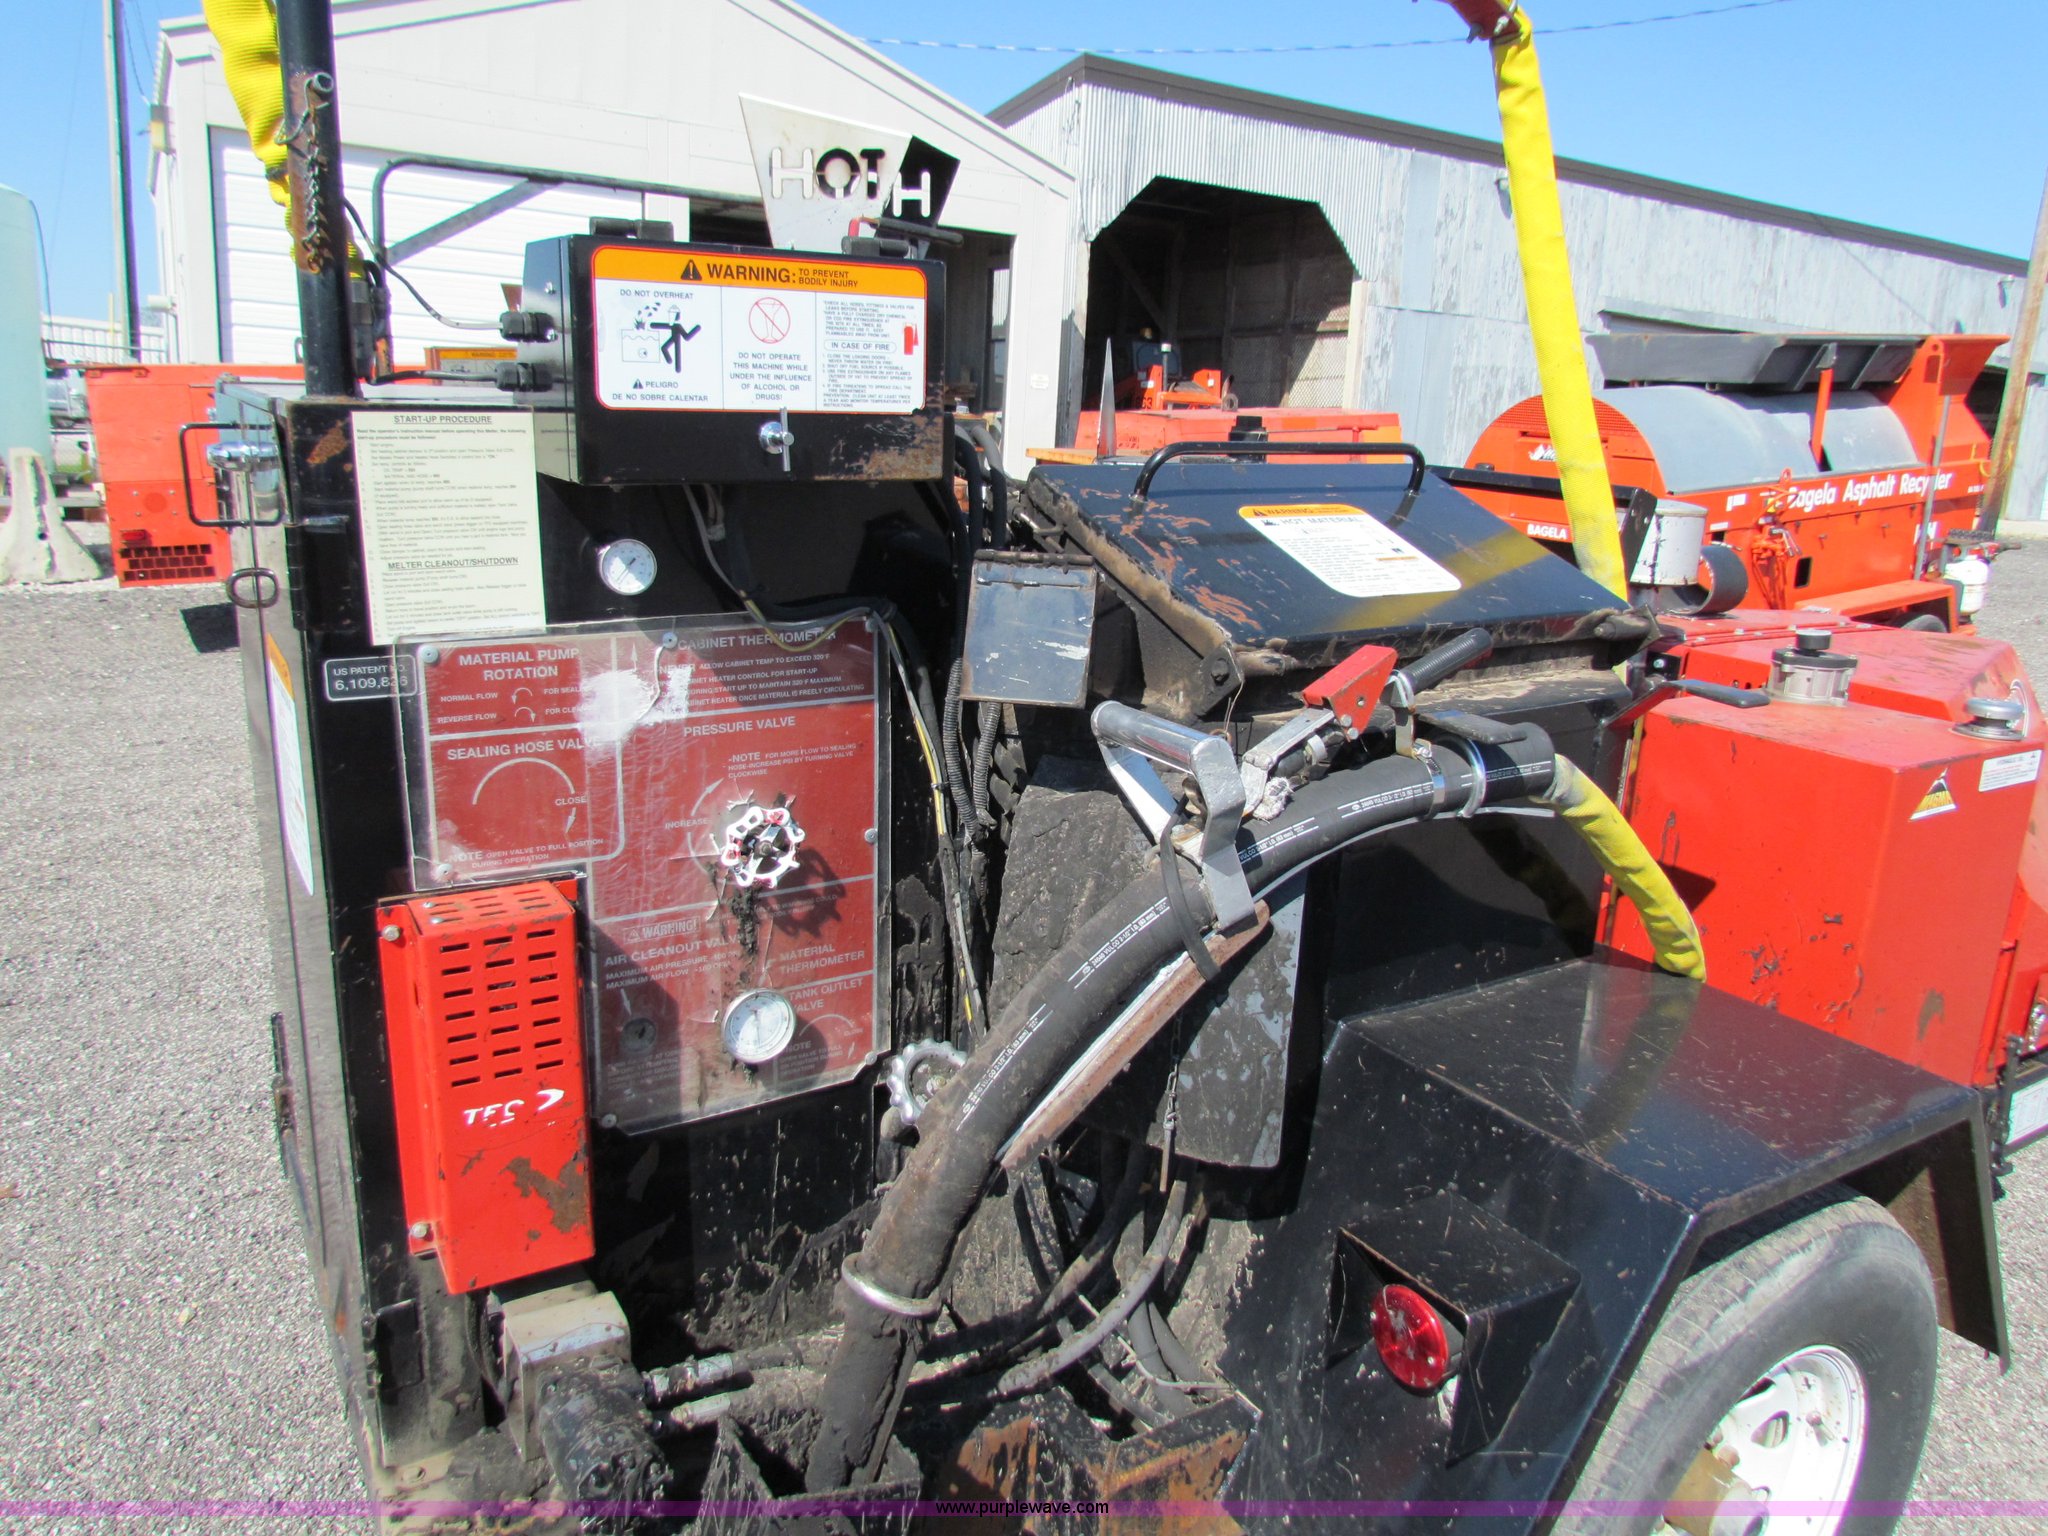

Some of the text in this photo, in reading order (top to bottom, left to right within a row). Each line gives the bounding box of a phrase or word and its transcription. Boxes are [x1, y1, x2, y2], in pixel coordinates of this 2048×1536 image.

[770, 148, 885, 200] HOT
[707, 263, 796, 284] WARNING:
[799, 268, 849, 278] TO PREVENT
[799, 277, 858, 288] BODILY INJURY
[620, 289, 631, 297] DO
[653, 291, 693, 300] OVERHEAT
[738, 352, 749, 360] DO
[769, 353, 800, 361] OPERATE
[733, 362, 749, 370] THIS
[645, 381, 679, 389] PELIGRO
[754, 383, 787, 391] ALCOHOL
[394, 415, 492, 423] START-UP PROCEDURE
[1842, 474, 1896, 506] Asphalt
[1899, 468, 1953, 498] Recyler
[1527, 523, 1568, 540] BAGELA
[388, 557, 518, 569] MELTER CLEANOUT/SHUTDOWN
[677, 635, 736, 650] CABINET
[459, 648, 580, 666] MATERIAL PUMP
[699, 662, 724, 670] ALLOW
[725, 659, 755, 668] CABINET
[756, 657, 774, 665] TEMP
[786, 654, 811, 663] EXCEED
[333, 668, 348, 676] US
[350, 666, 388, 675] PATENT
[483, 666, 559, 681] ROTATION
[708, 675, 736, 683] HEATER
[737, 671, 772, 681] CONTROL
[786, 667, 817, 676] START-UP
[738, 684, 748, 692] UP
[758, 680, 791, 689] MAINTAIN
[810, 676, 842, 684] MAXIMUM
[440, 692, 498, 703] NORMAL FLOW
[738, 693, 758, 702] ONCE
[758, 690, 790, 700] MATERIAL
[799, 688, 822, 696] FREELY
[824, 684, 864, 693] CIRCULATING
[437, 713, 497, 723] REVERSE FLOW
[683, 716, 796, 737] PRESSURE VALVE
[447, 744, 510, 760] SEALING
[515, 740, 554, 754] HOSE
[780, 750, 799, 758] MORE
[830, 743, 857, 751] SEALING
[728, 760, 781, 770] HOSE-INCREASE
[805, 753, 832, 762] TURNING
[834, 751, 854, 759] VALVE
[728, 770, 768, 780] CLOCKWISE
[555, 796, 587, 806] CLOSE
[665, 818, 708, 829] INCREASE
[486, 850, 507, 858] OPEN
[510, 847, 533, 856] VALVE
[547, 843, 567, 851] FULL
[568, 839, 603, 849] POSITION
[506, 853, 549, 864] OPERATION
[642, 919, 697, 938] WARNING!
[604, 955, 628, 967] AIR
[631, 941, 702, 960] CLEANOUT
[780, 944, 836, 960] MATERIAL
[606, 967, 648, 980] MAXIMUM
[665, 956, 708, 968] PRESSURE
[779, 951, 865, 972] THERMOMETER
[606, 976, 648, 989] MAXIMUM
[665, 969, 689, 978] FLOW
[790, 978, 864, 1000] TANK OUTLET
